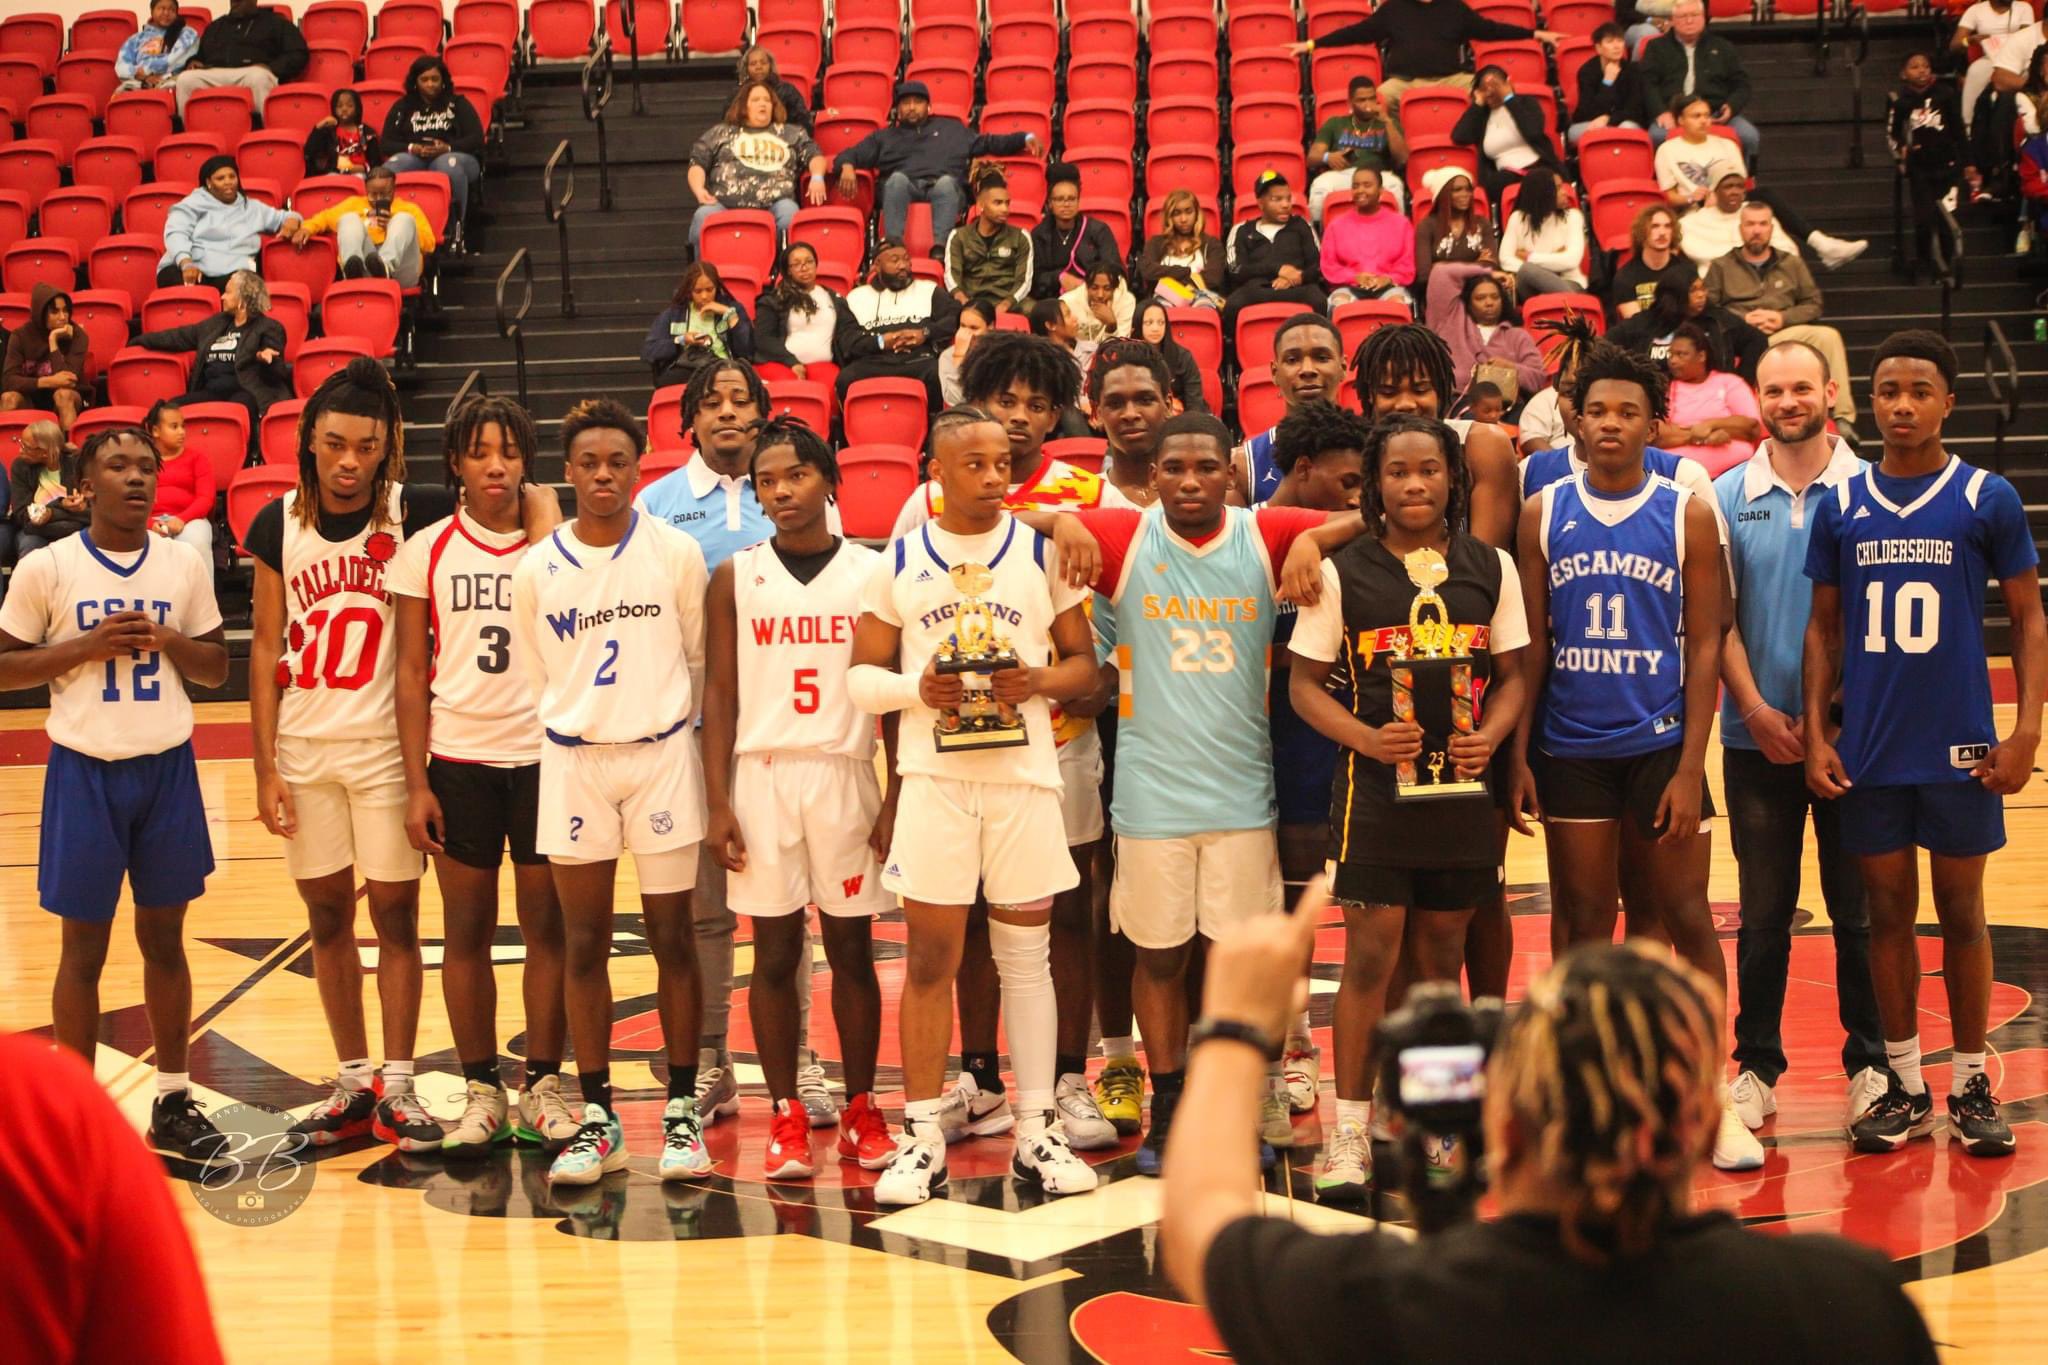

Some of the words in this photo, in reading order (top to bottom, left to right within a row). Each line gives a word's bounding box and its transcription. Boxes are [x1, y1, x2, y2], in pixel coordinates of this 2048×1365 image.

[673, 510, 706, 524] COACH
[1738, 510, 1770, 522] COACH
[1550, 550, 1676, 594] ESCAMBIA
[1856, 538, 1953, 567] CHILDERSBURG
[751, 615, 861, 646] WADLEY
[1143, 594, 1259, 624] SAINTS
[1585, 592, 1628, 640] 11
[1864, 581, 1941, 654] 10
[296, 607, 384, 691] 10
[477, 625, 512, 675] 3
[594, 639, 620, 686] 2
[1170, 628, 1236, 673] 23
[1555, 646, 1664, 675] COUNTY
[102, 648, 160, 702] 12
[793, 668, 820, 714] 5
[569, 816, 584, 842] 2
